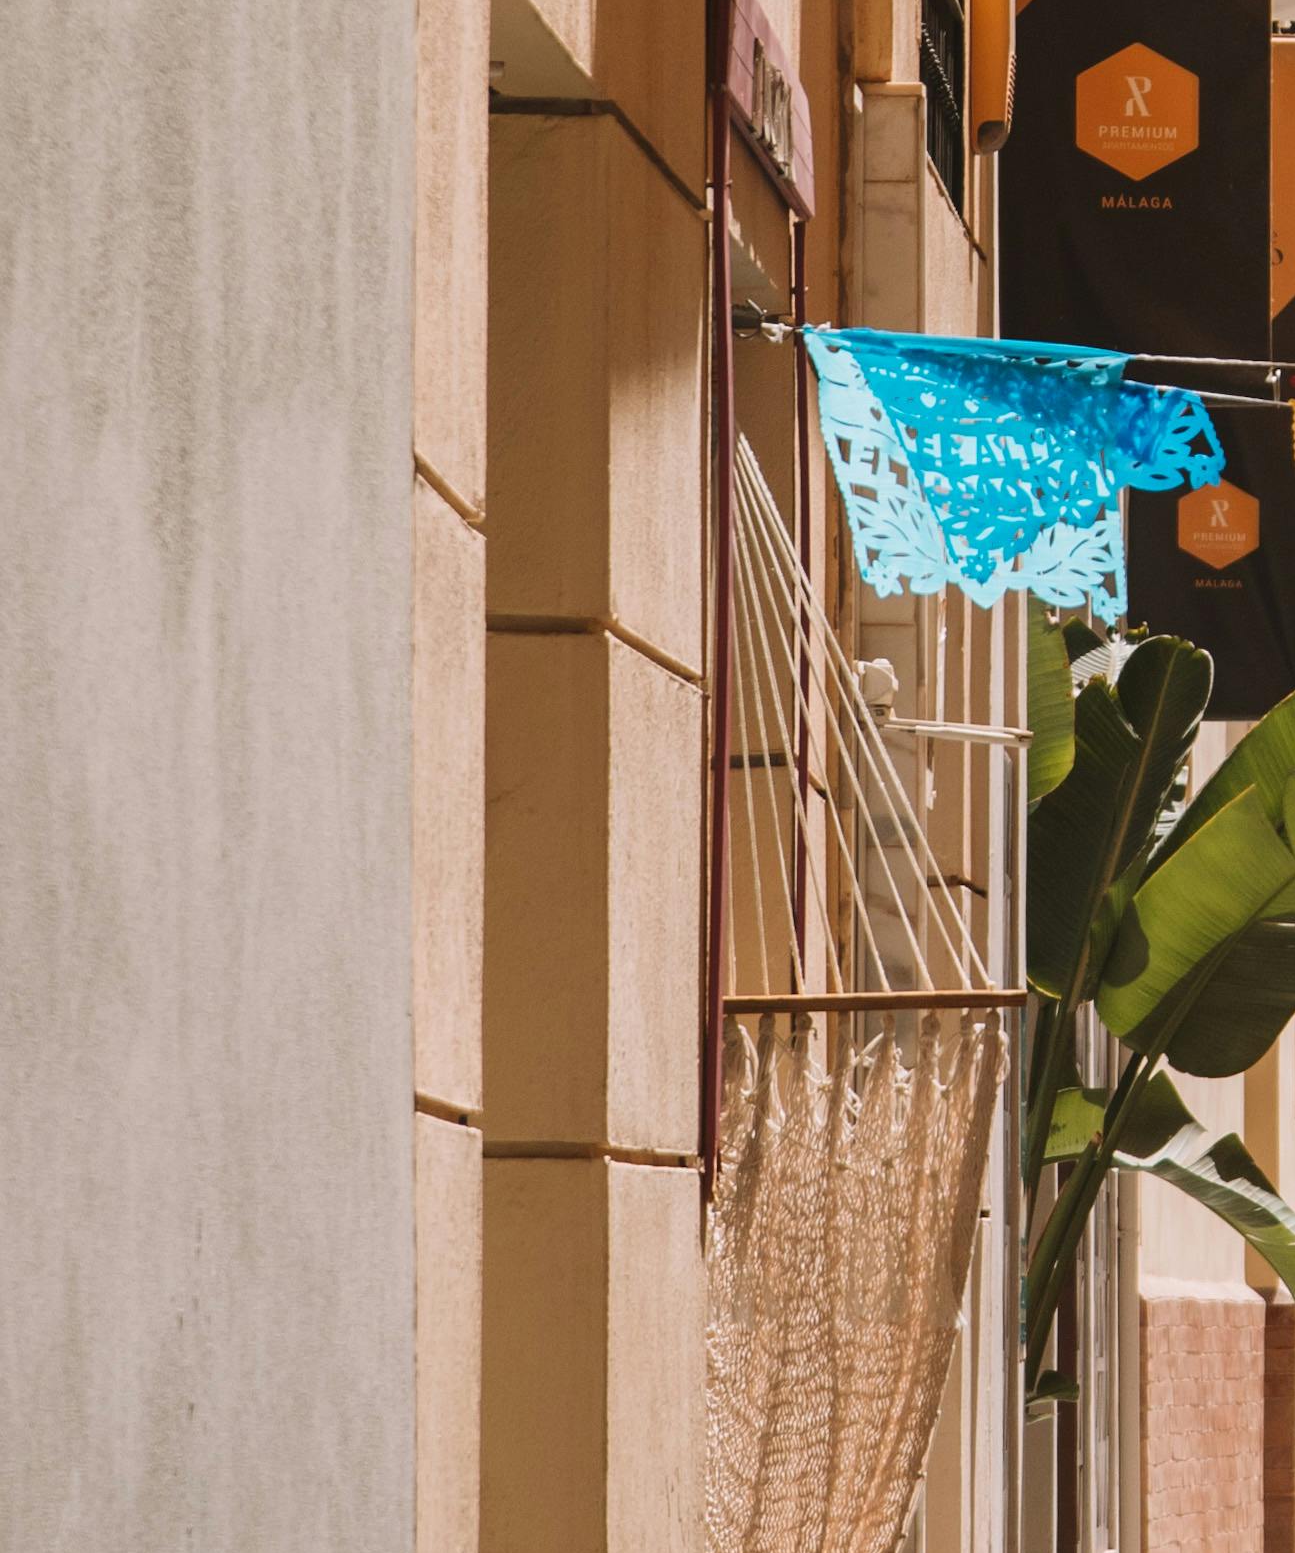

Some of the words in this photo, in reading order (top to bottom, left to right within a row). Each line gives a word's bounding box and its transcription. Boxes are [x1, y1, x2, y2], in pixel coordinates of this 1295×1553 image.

[1098, 125, 1177, 139] PREMIUM
[1101, 193, 1173, 209] MÁLAGA
[1193, 532, 1247, 542] PREMIUM
